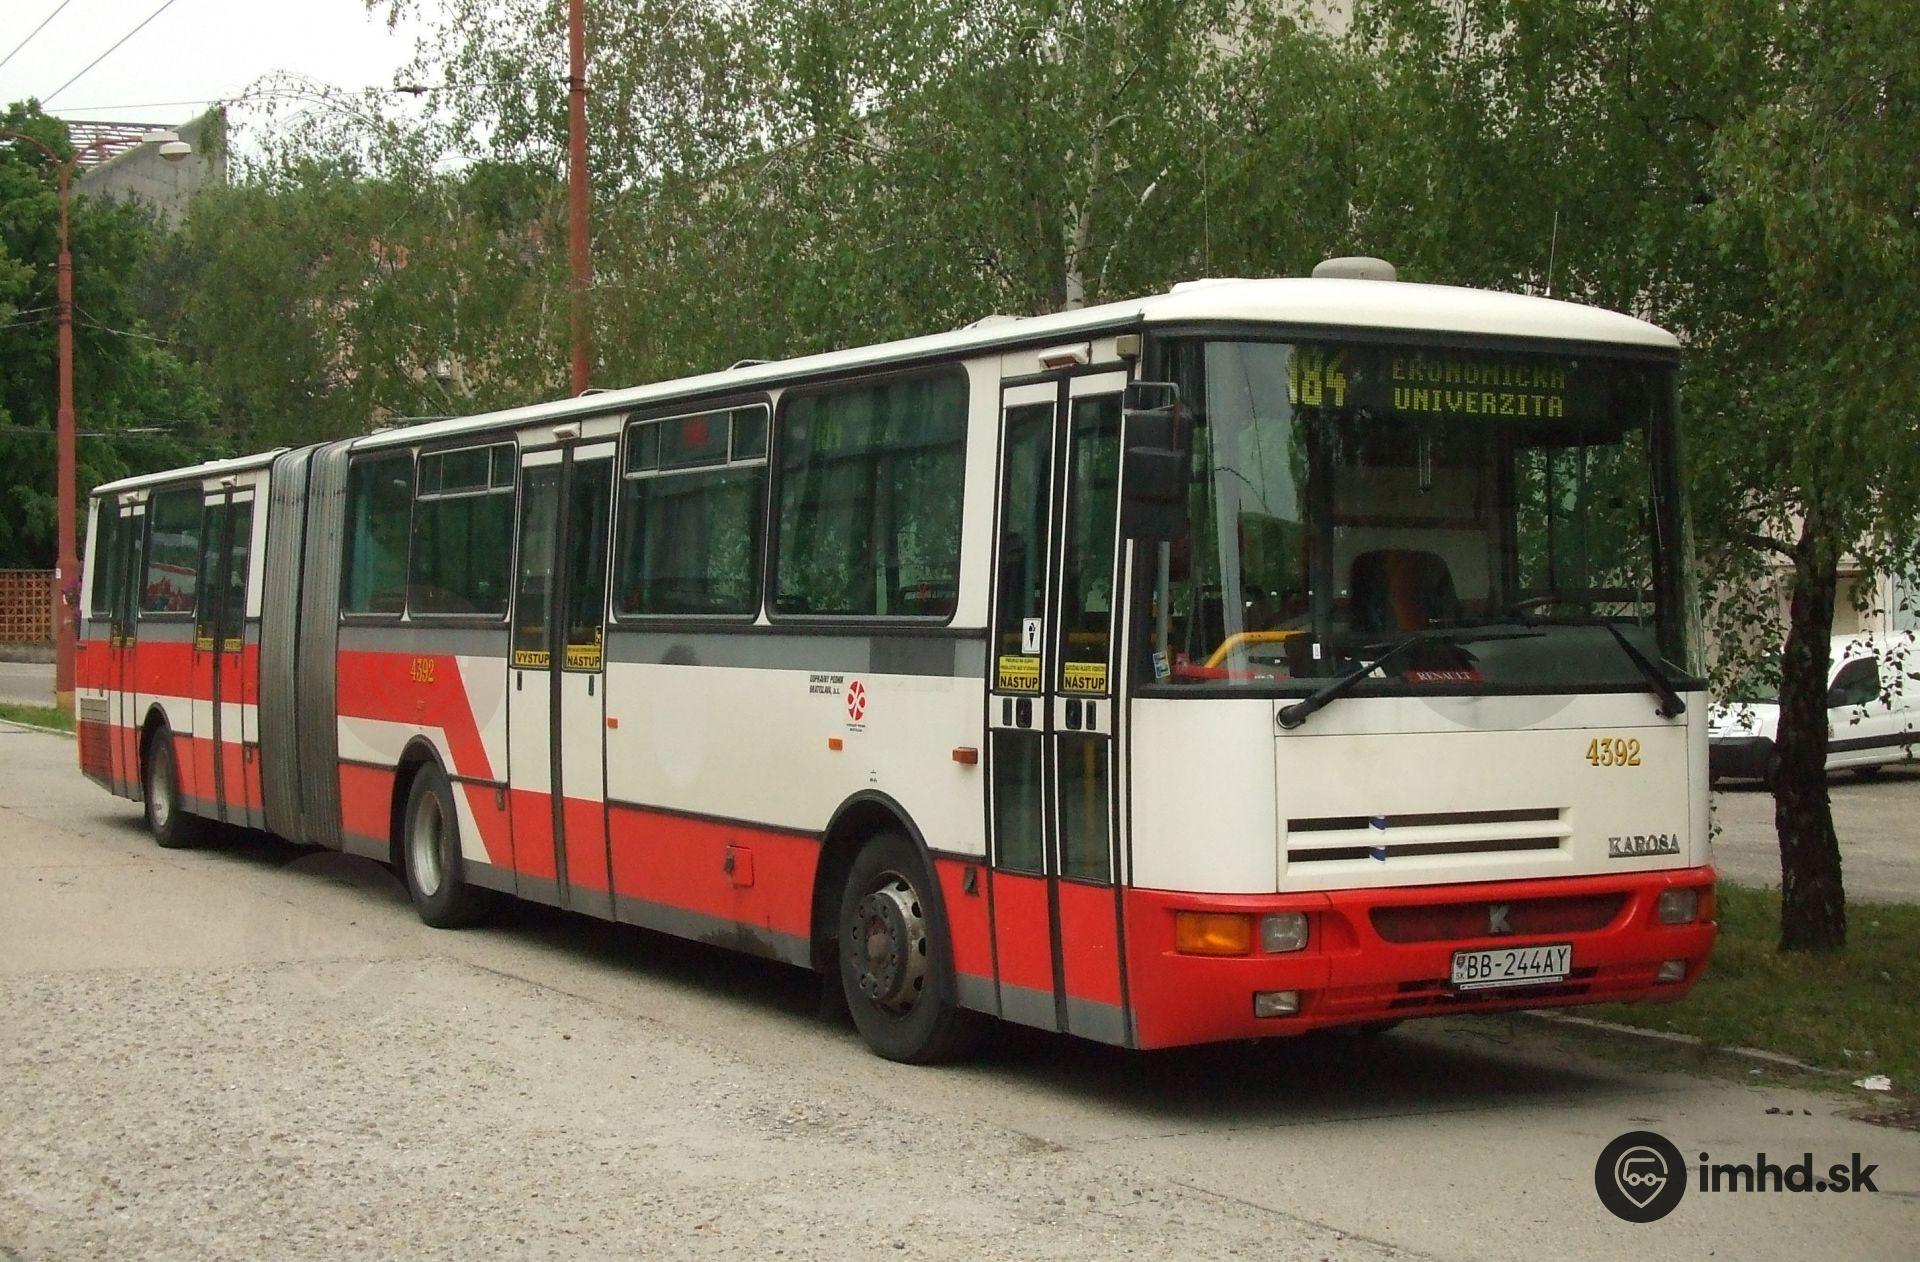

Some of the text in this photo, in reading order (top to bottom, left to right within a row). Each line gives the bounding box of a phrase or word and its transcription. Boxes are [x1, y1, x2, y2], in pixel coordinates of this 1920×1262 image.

[1394, 388, 1563, 417] UNIVERZITA
[410, 658, 434, 682] 4392
[1000, 674, 1038, 689] NÁSTUP
[1416, 671, 1471, 681] RENAULT
[1064, 674, 1104, 690] NÁSTUP
[1586, 738, 1641, 767] 4392
[1608, 833, 1680, 856] KAROSA
[1467, 948, 1568, 979] BB-244AY
